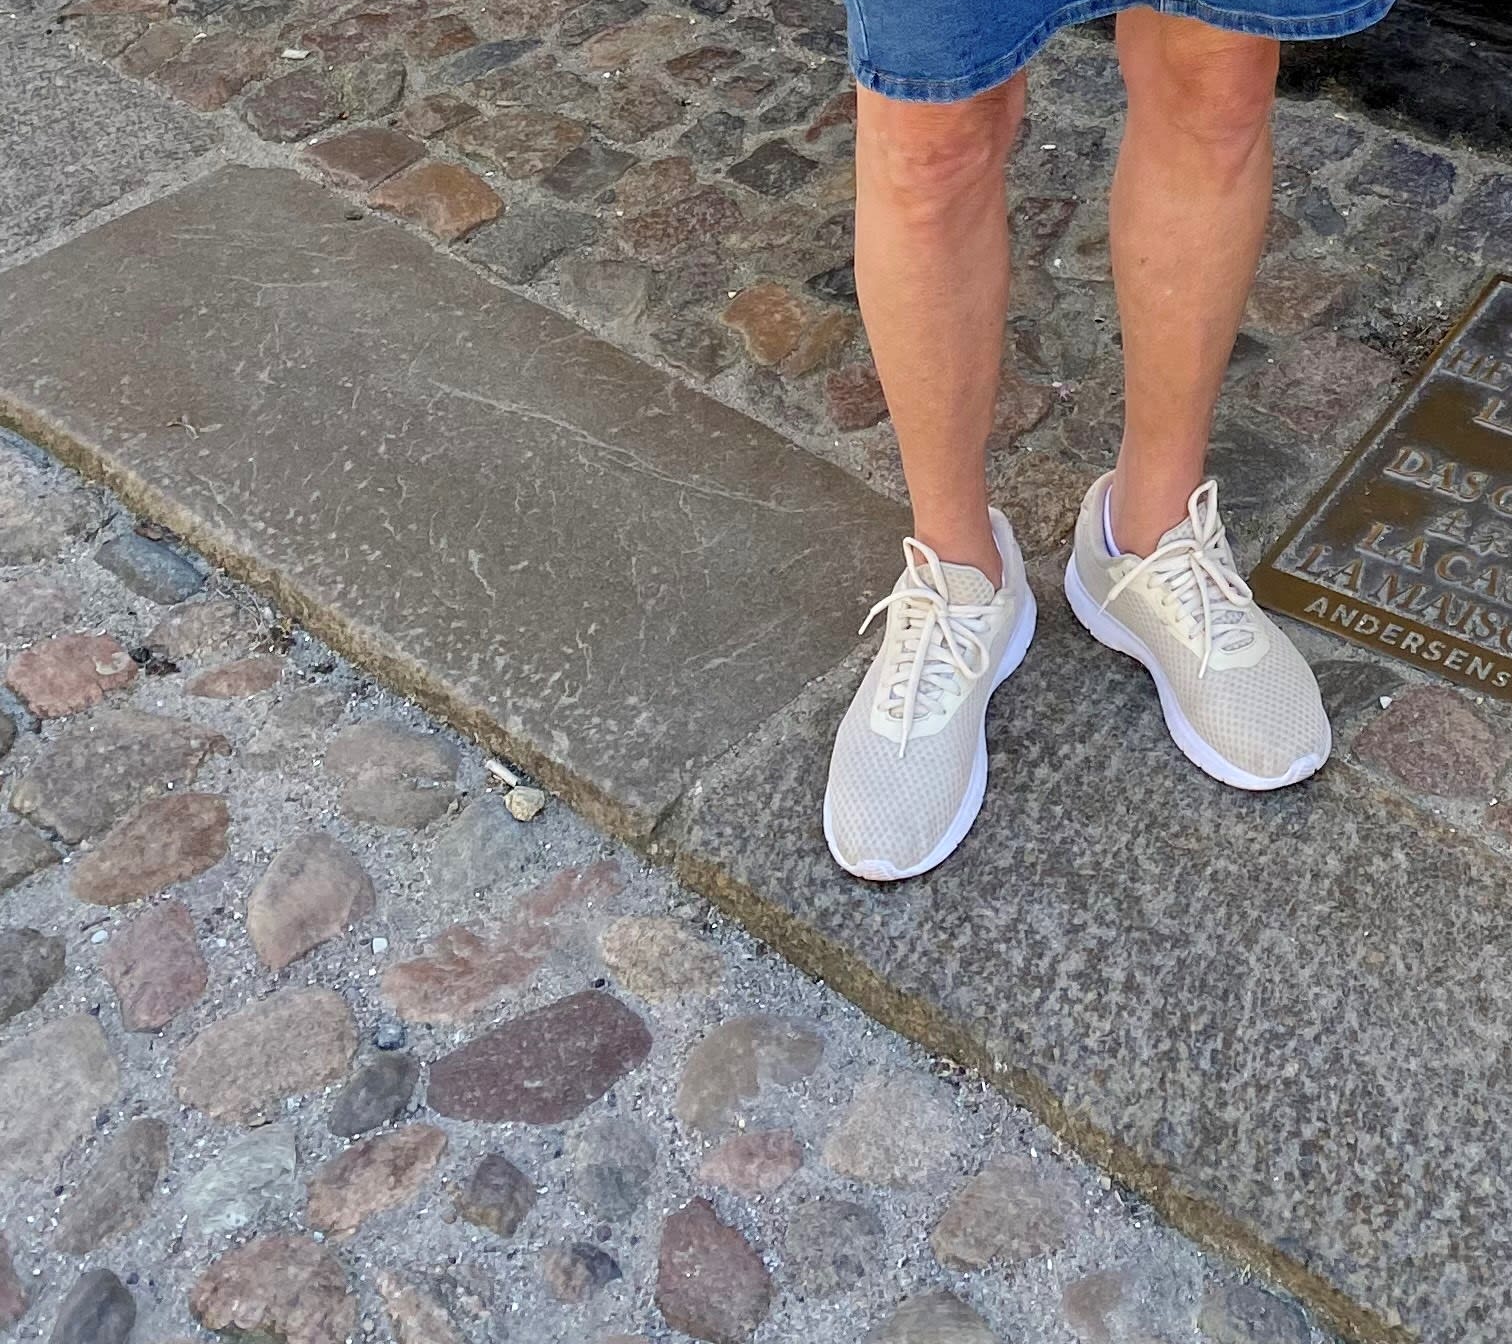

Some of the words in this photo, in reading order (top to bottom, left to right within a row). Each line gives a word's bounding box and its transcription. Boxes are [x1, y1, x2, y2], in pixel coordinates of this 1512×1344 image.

[1385, 447, 1489, 502] DAS
[1295, 543, 1364, 593] LA
[1355, 521, 1429, 572] LA
